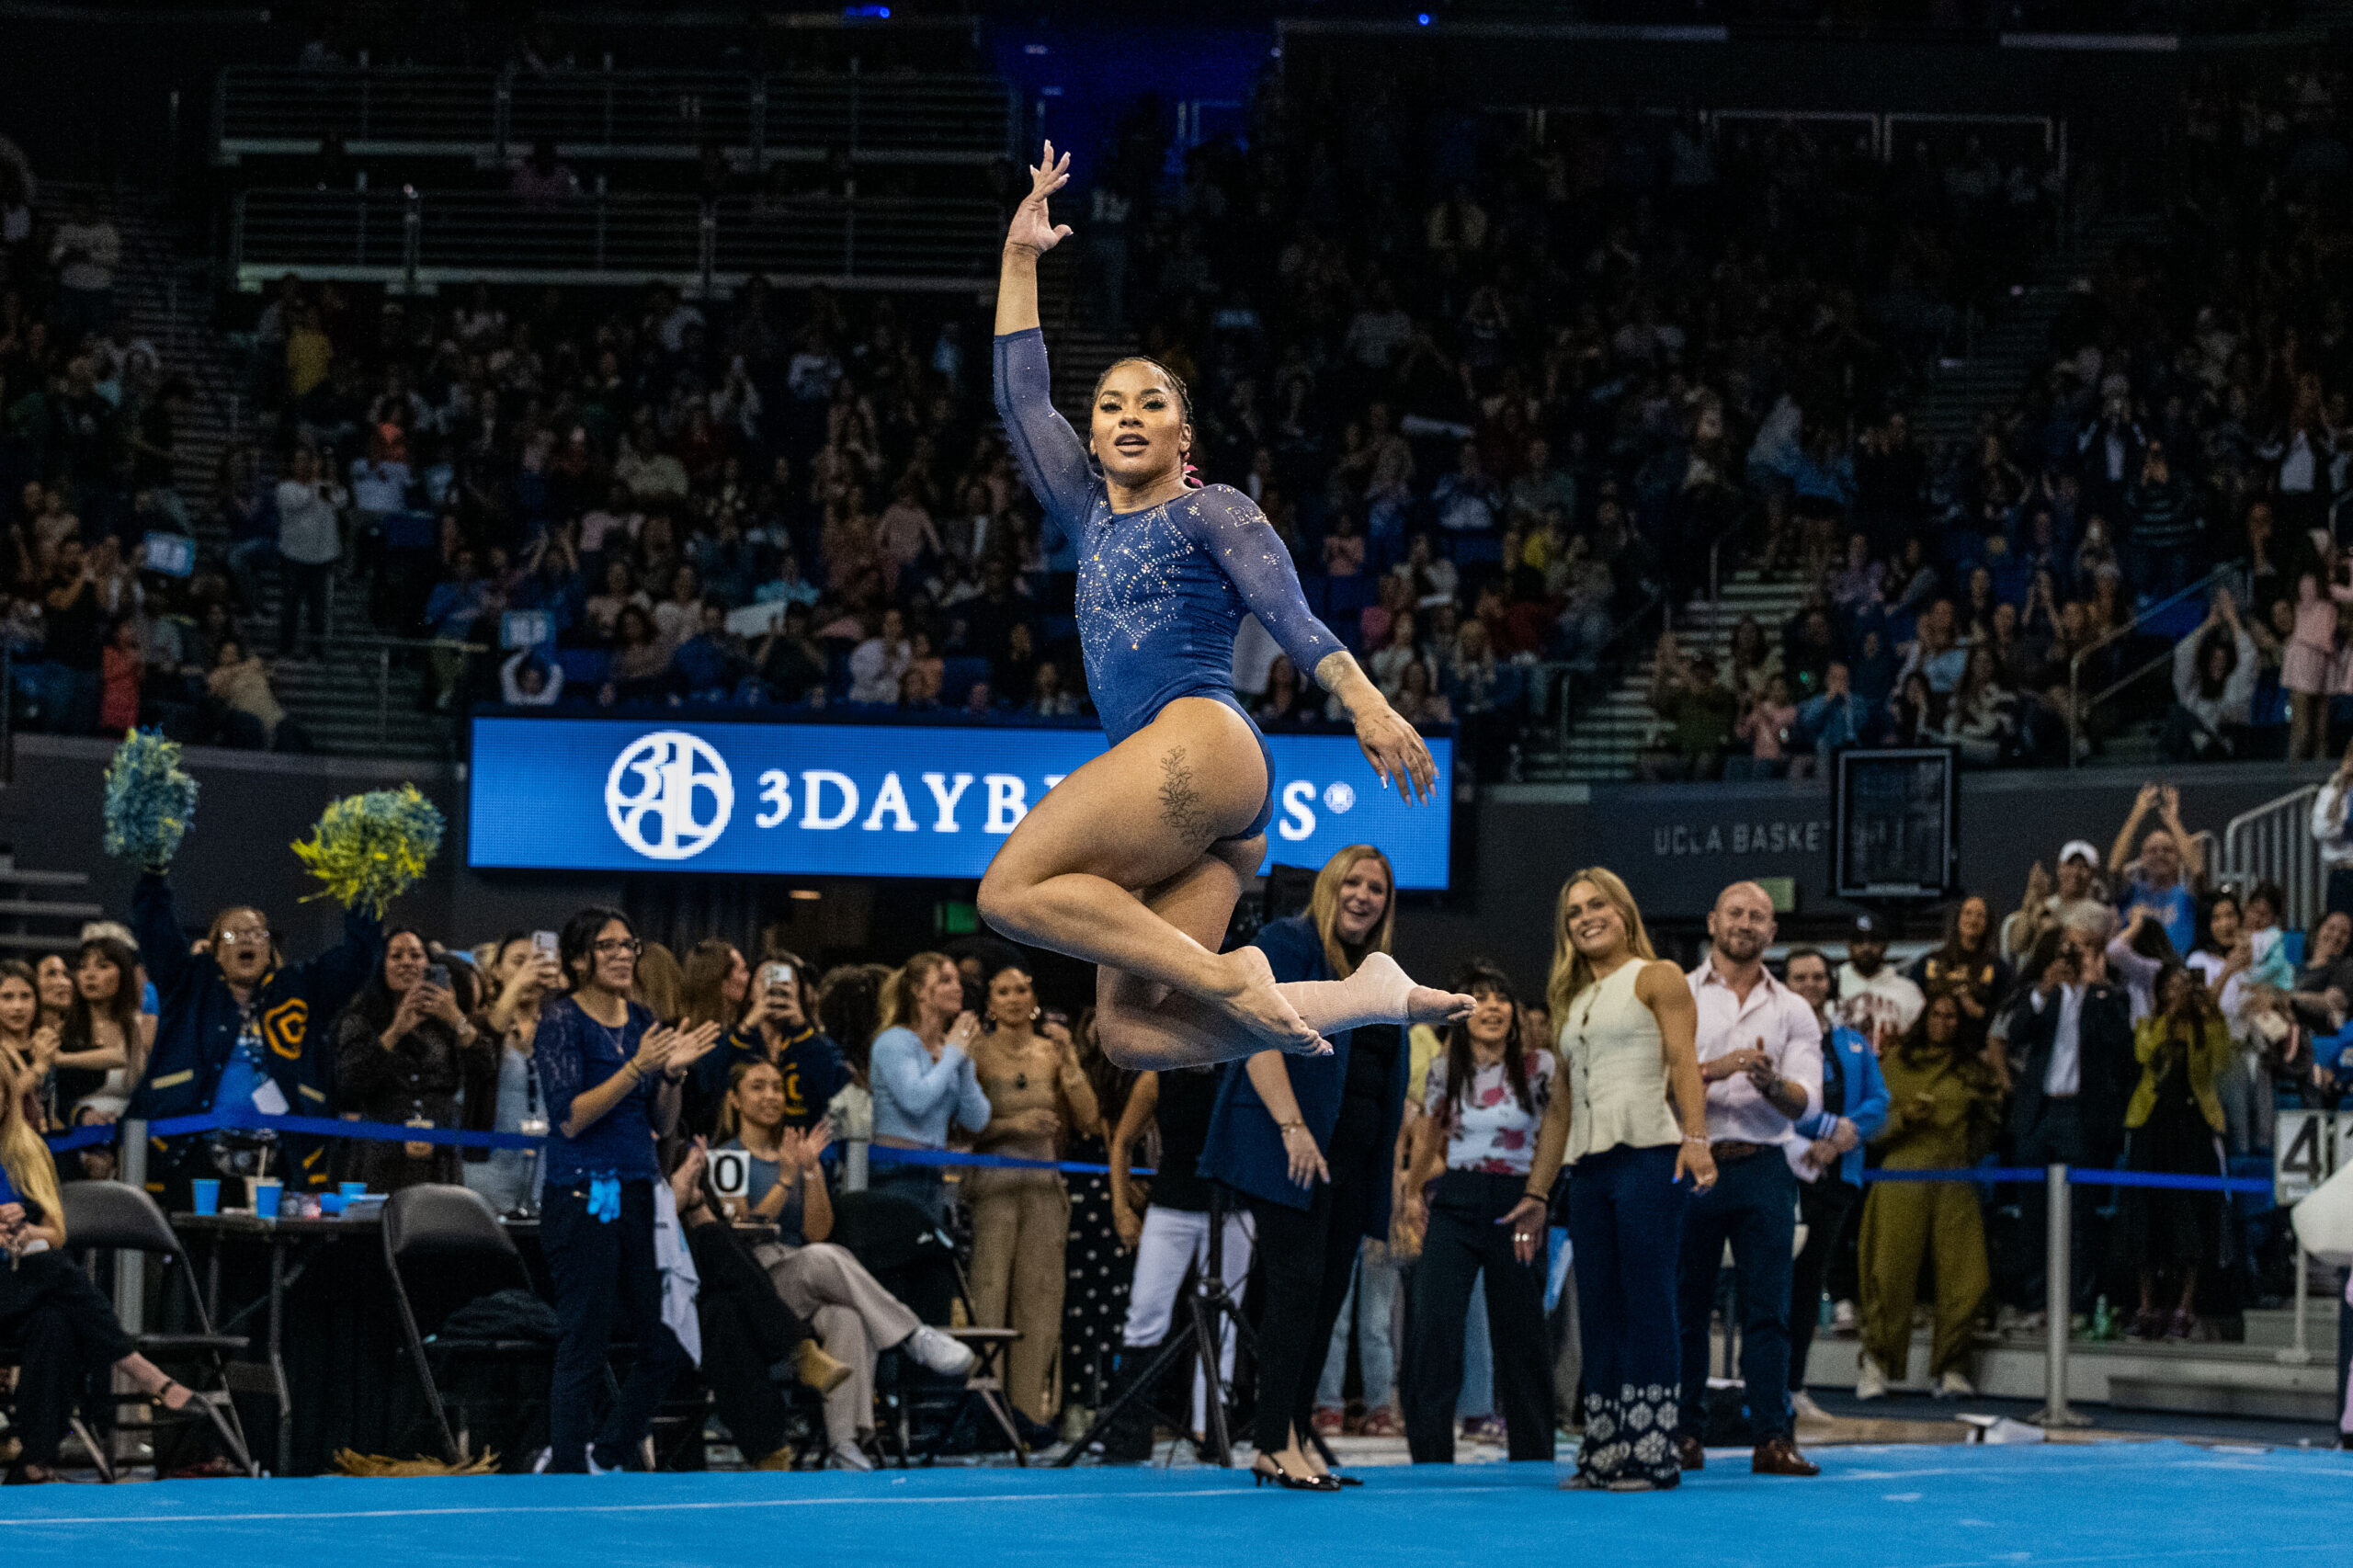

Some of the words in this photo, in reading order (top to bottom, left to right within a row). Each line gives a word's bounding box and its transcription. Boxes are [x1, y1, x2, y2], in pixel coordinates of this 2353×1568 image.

[1654, 825, 1722, 855] UCLA
[2282, 1114, 2321, 1184] 4
[714, 1154, 743, 1192] 0
